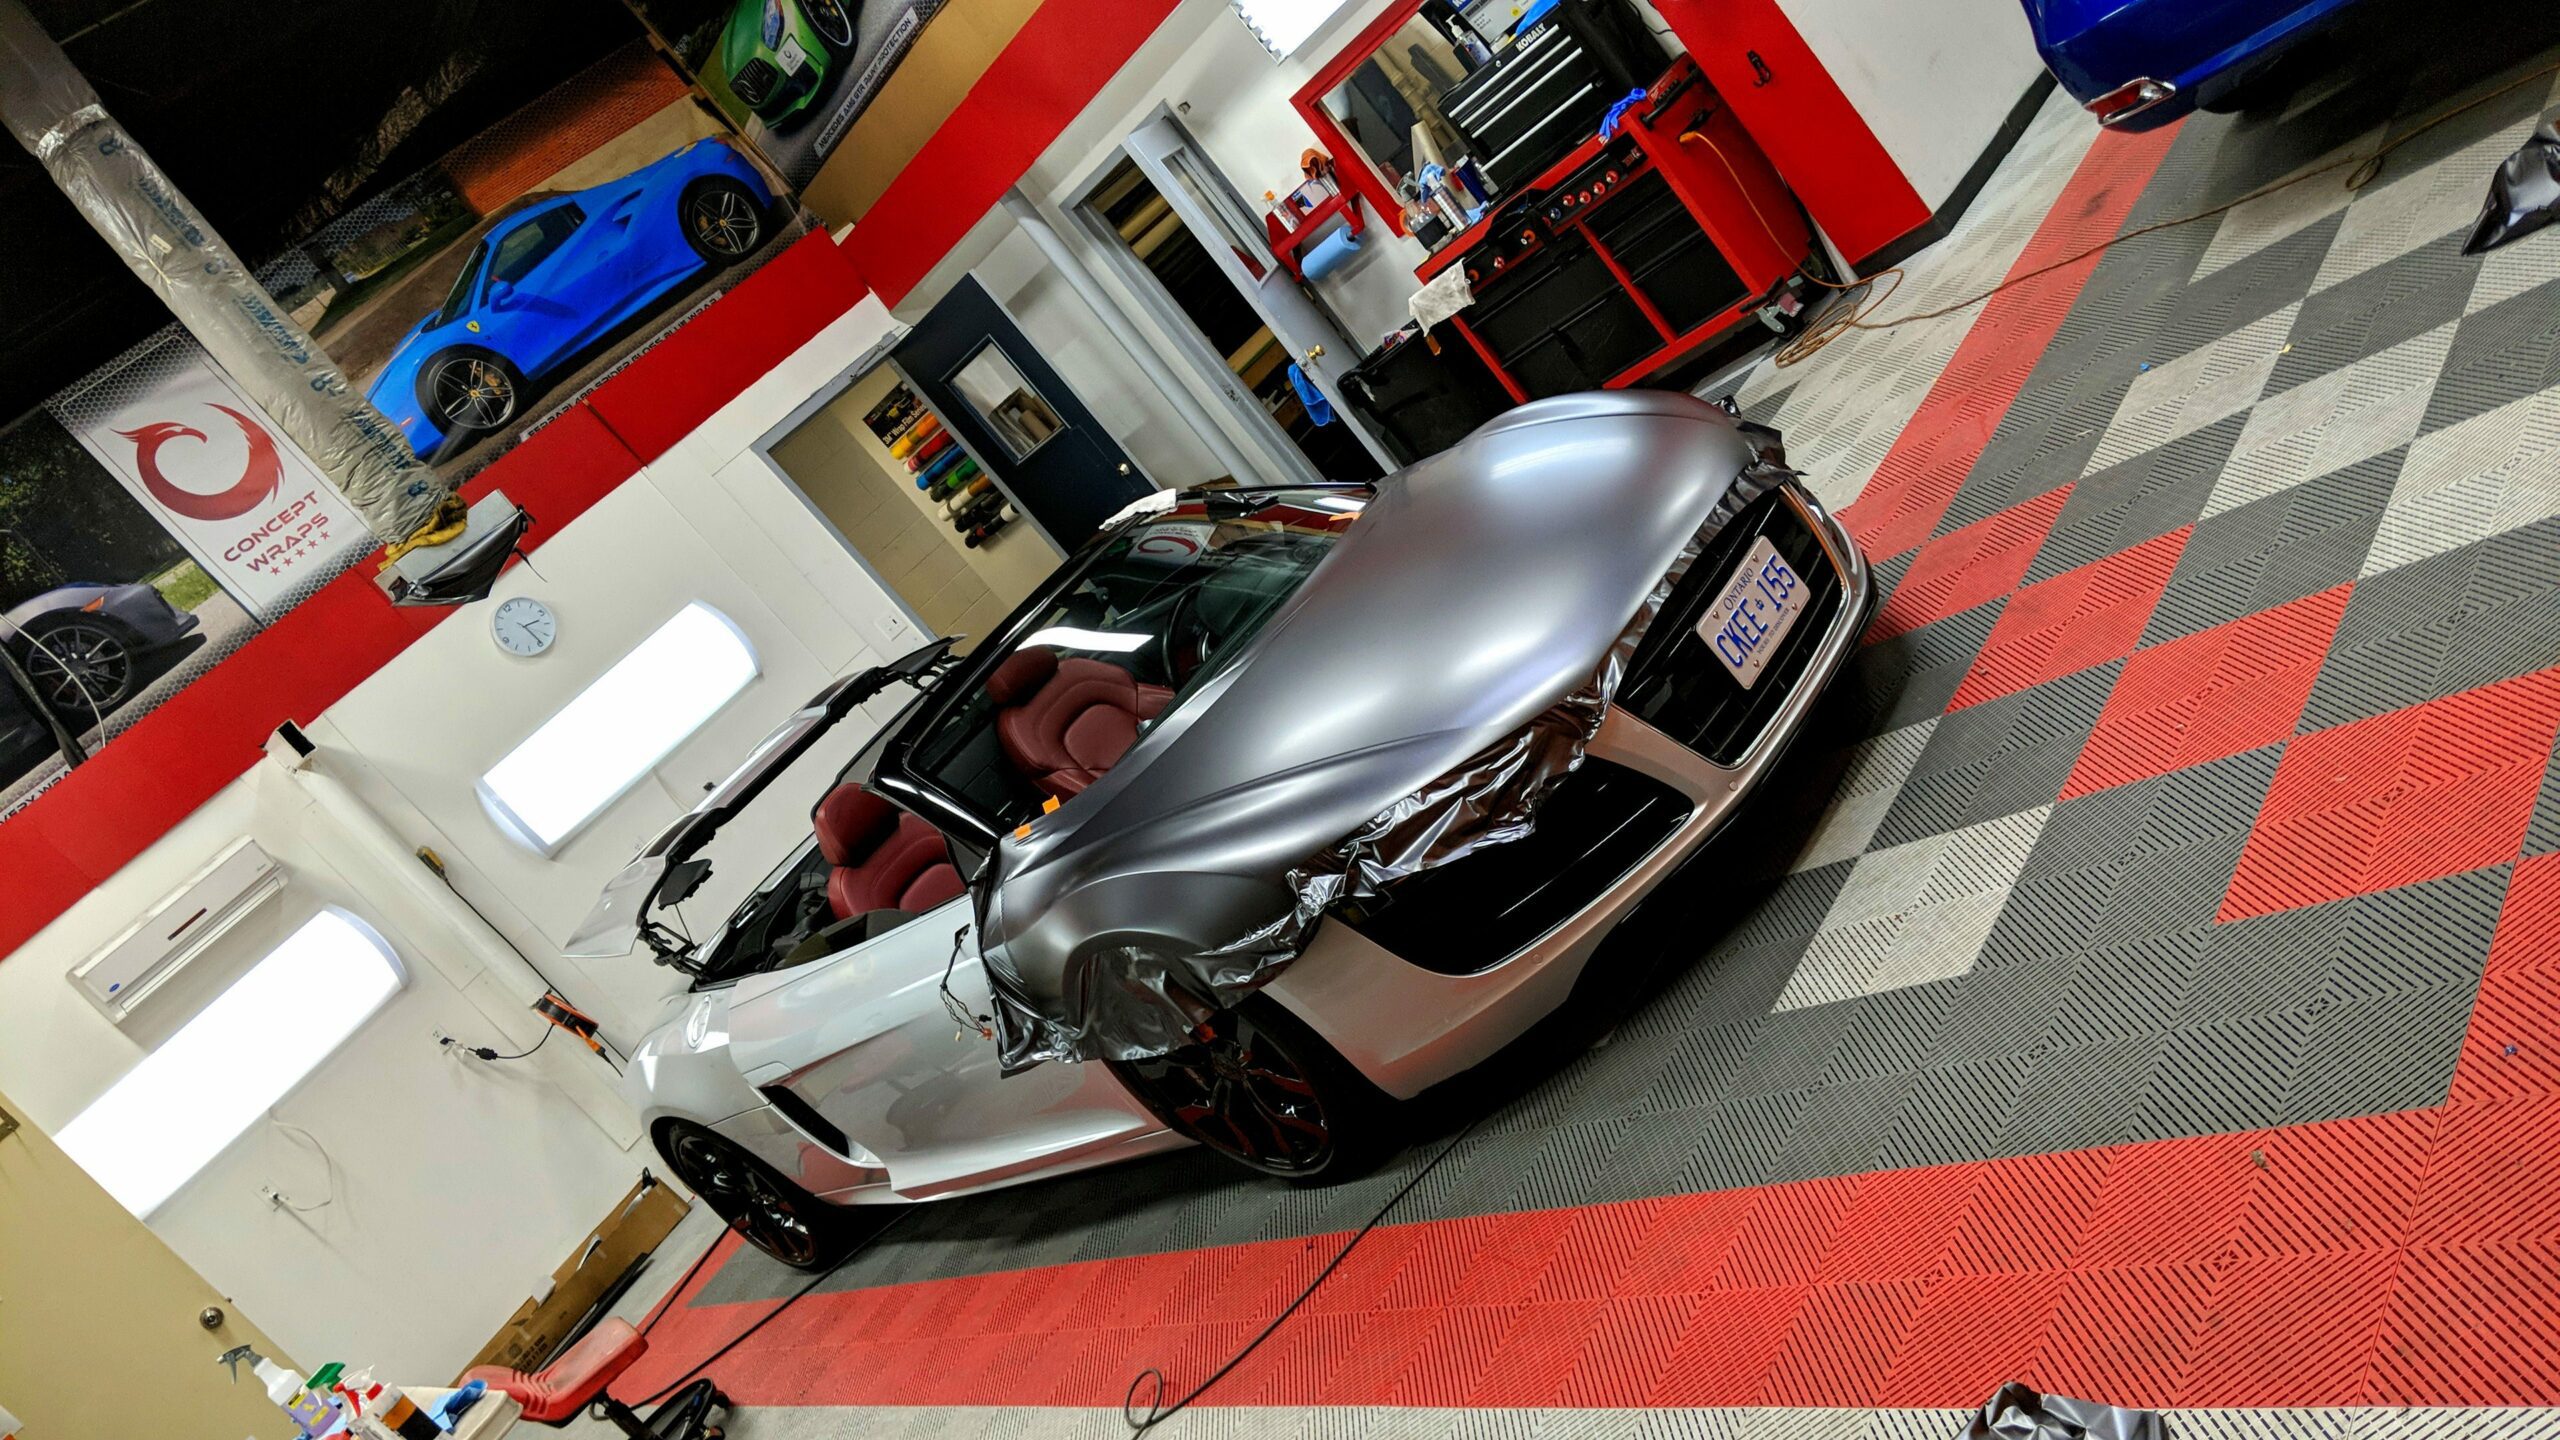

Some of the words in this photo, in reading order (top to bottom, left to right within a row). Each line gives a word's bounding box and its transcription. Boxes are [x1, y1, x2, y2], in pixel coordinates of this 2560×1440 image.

[1515, 22, 1547, 52] KOBALT
[818, 112, 845, 149] MERCEDES
[854, 83, 868, 99] GTR
[864, 63, 881, 88] PAINT
[878, 17, 912, 67] PROTECTION
[890, 423, 906, 437] Wrap
[223, 490, 318, 562] CONCEPT
[246, 512, 329, 572] WRAPS
[1715, 598, 1769, 669] CKEE
[1755, 553, 1796, 613] 155
[1723, 567, 1754, 611] ONTARIO
